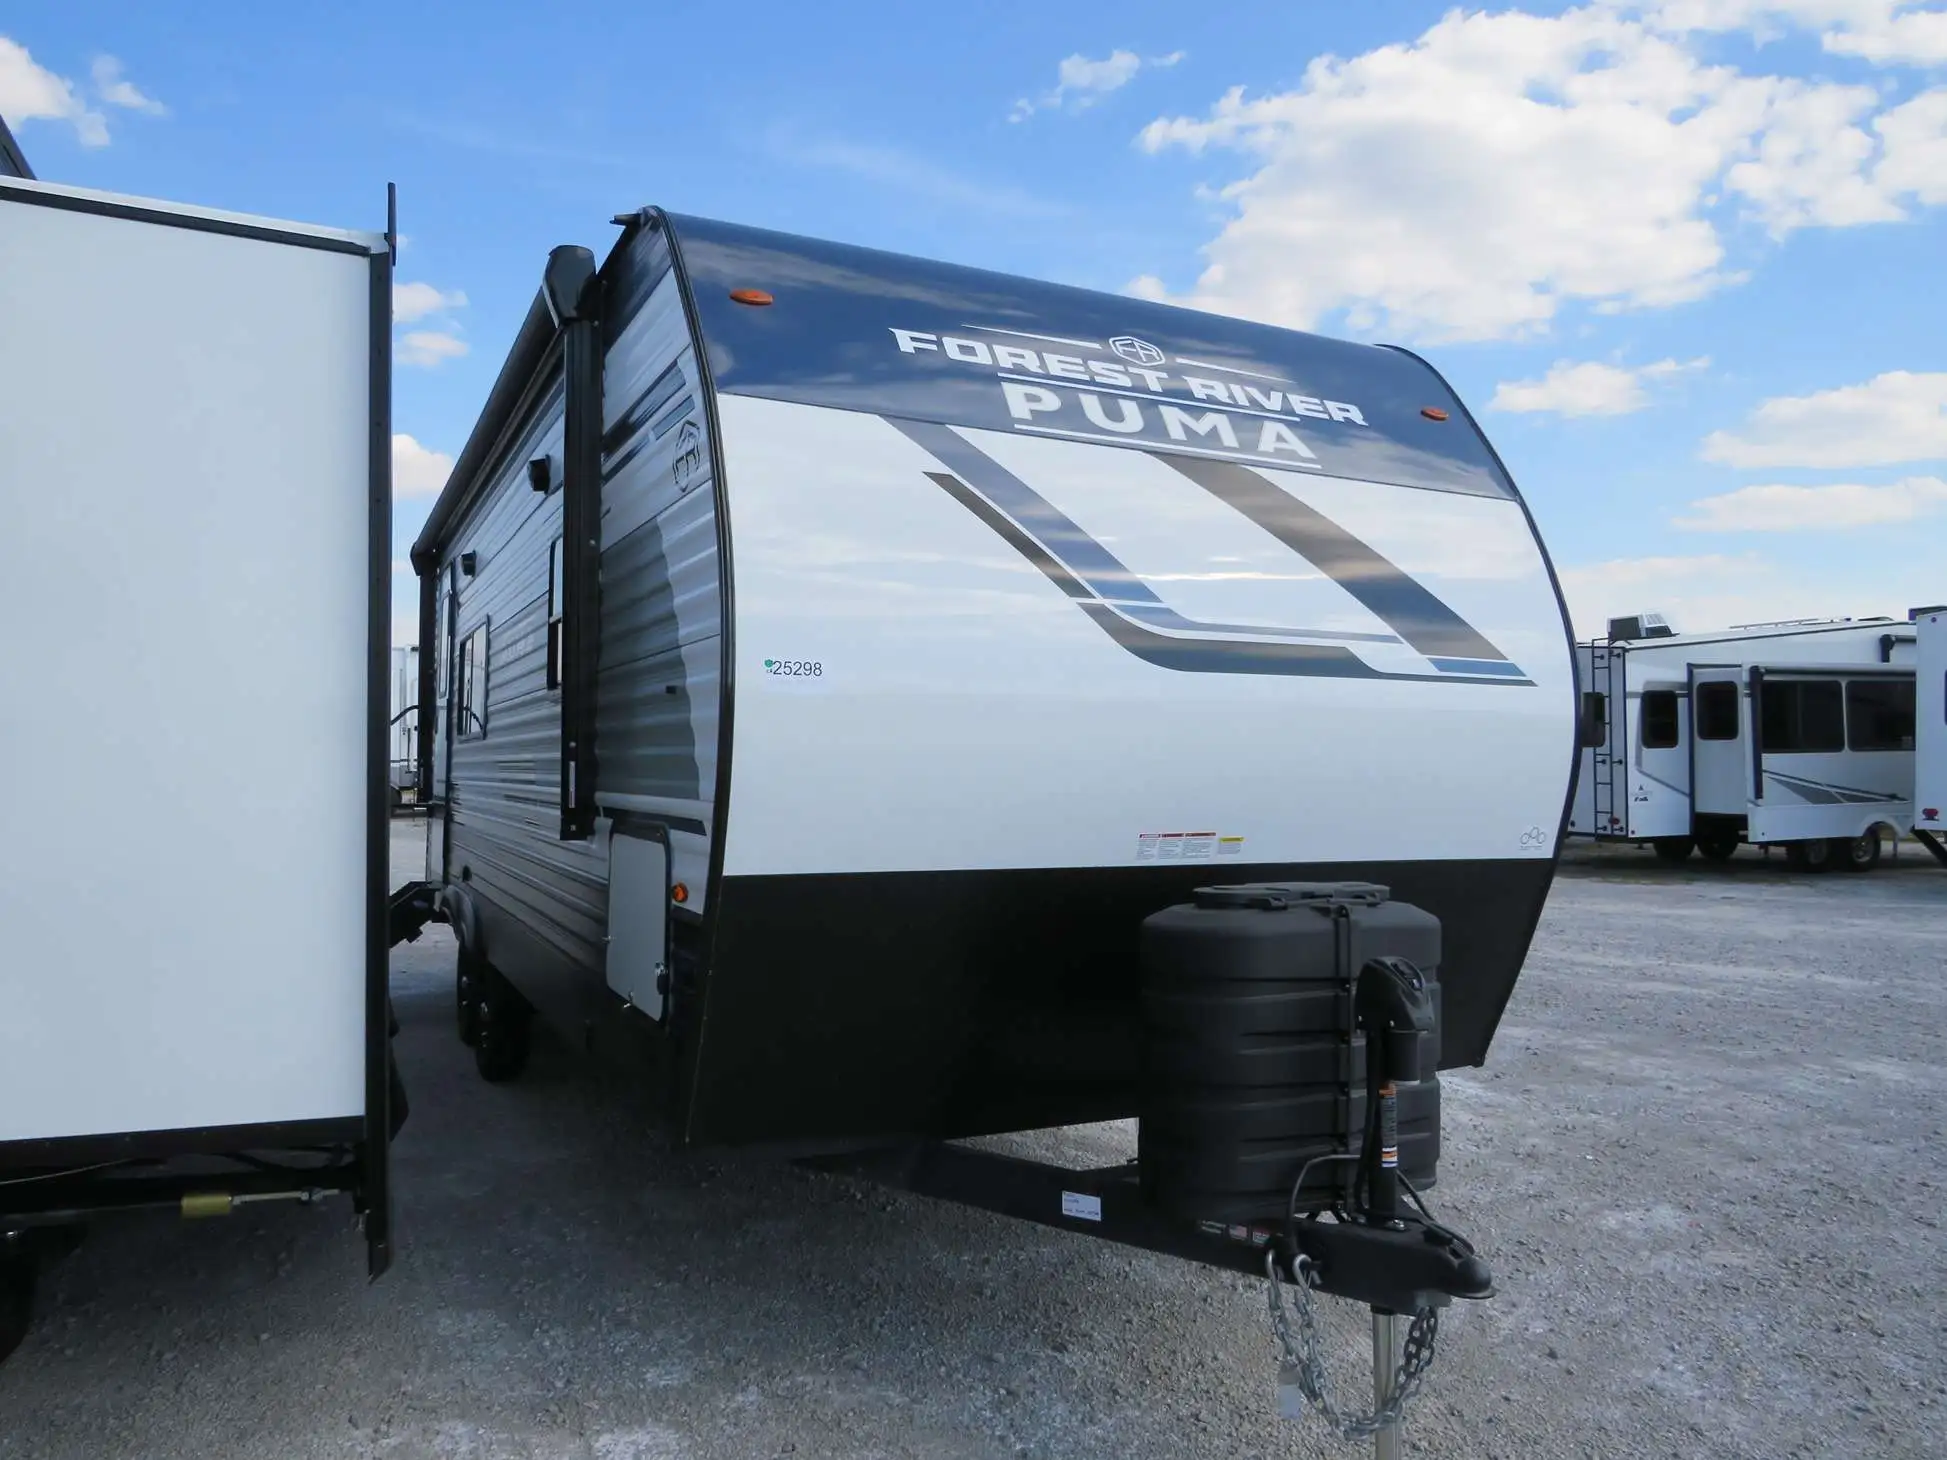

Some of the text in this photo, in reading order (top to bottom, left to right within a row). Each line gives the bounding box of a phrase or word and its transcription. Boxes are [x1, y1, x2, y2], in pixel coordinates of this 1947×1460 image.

[888, 328, 1369, 426] FOREST RIVER
[1001, 382, 1317, 460] PUMA
[773, 660, 822, 676] 25298
